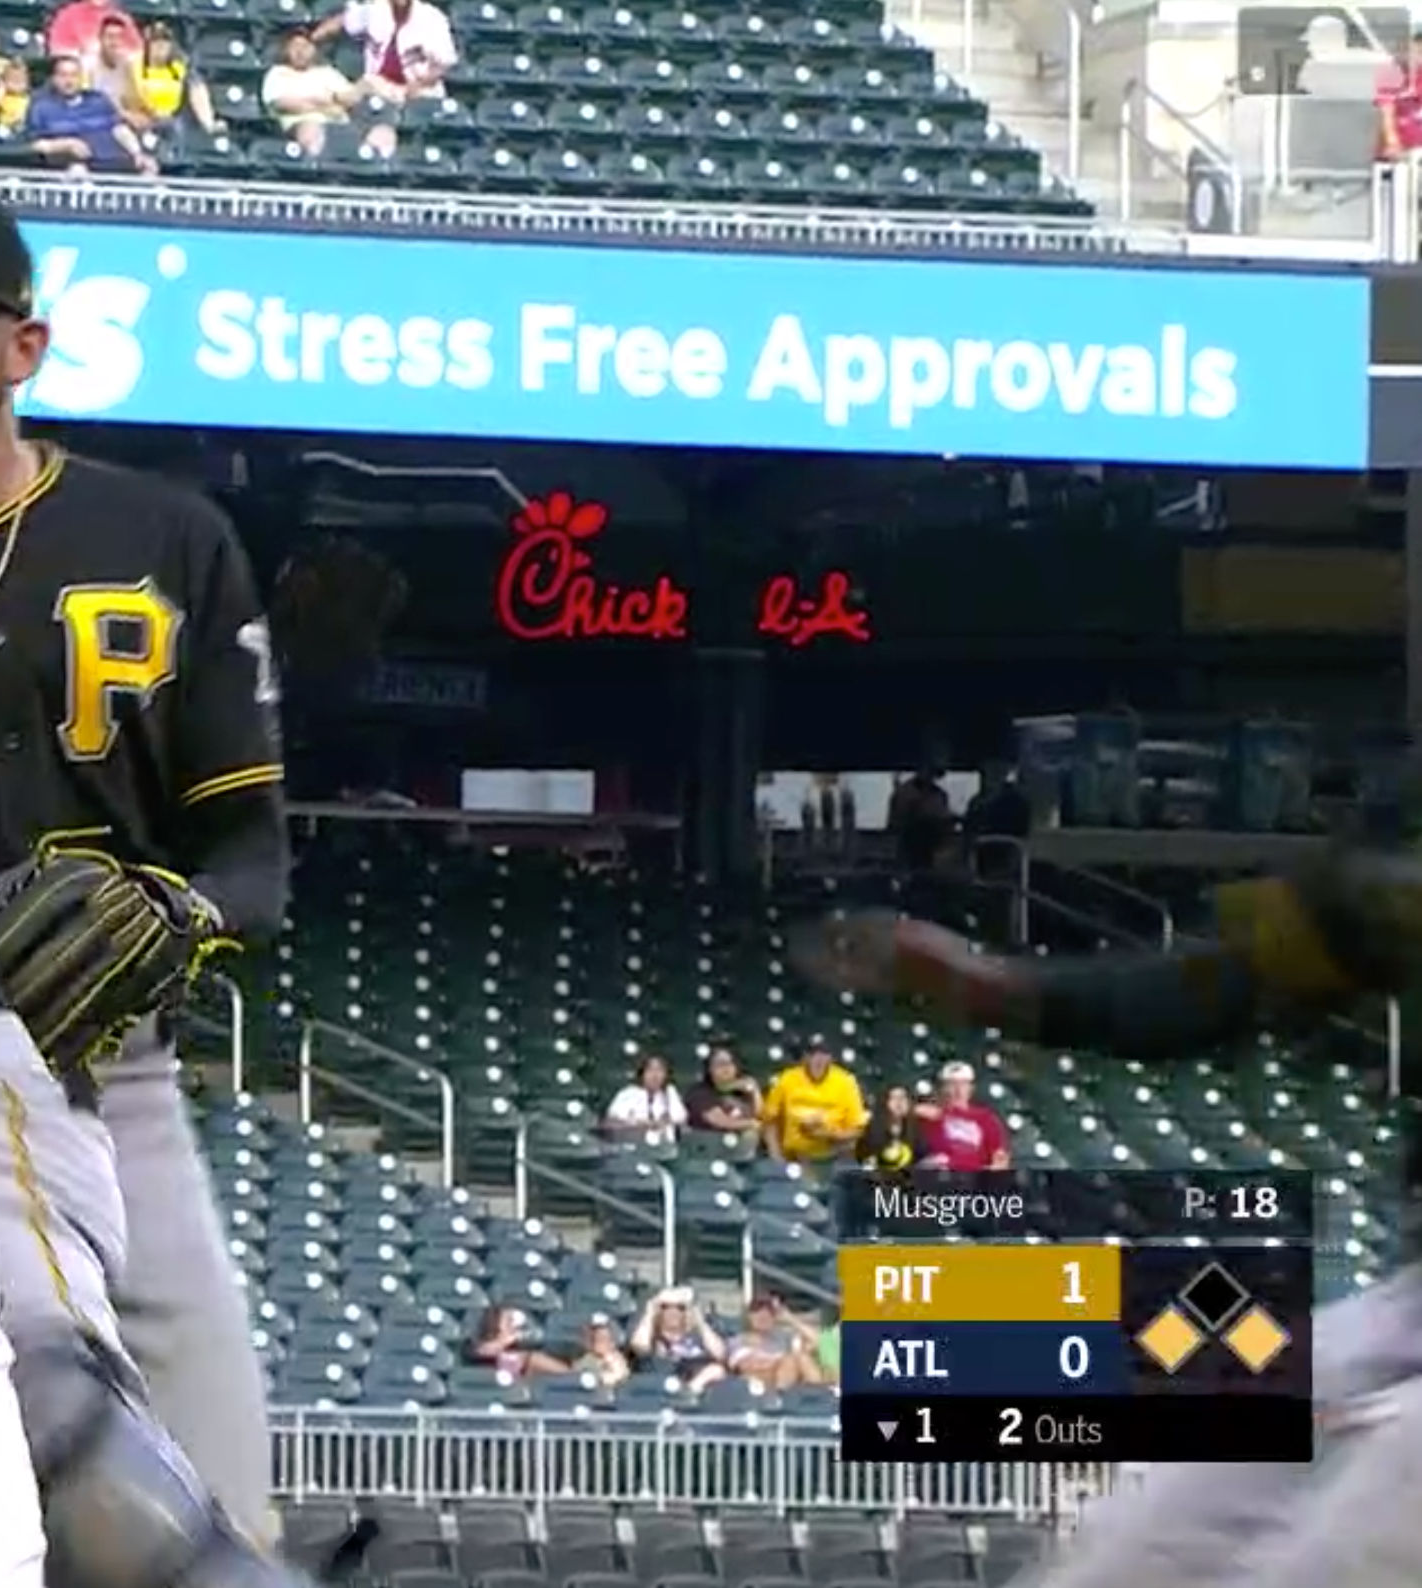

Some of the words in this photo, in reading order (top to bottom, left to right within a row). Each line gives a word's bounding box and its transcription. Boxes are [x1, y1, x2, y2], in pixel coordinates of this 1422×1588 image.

[195, 289, 494, 389] Stress
[521, 303, 726, 399] Free
[747, 315, 1238, 419] Approvals
[52, 576, 186, 762] P
